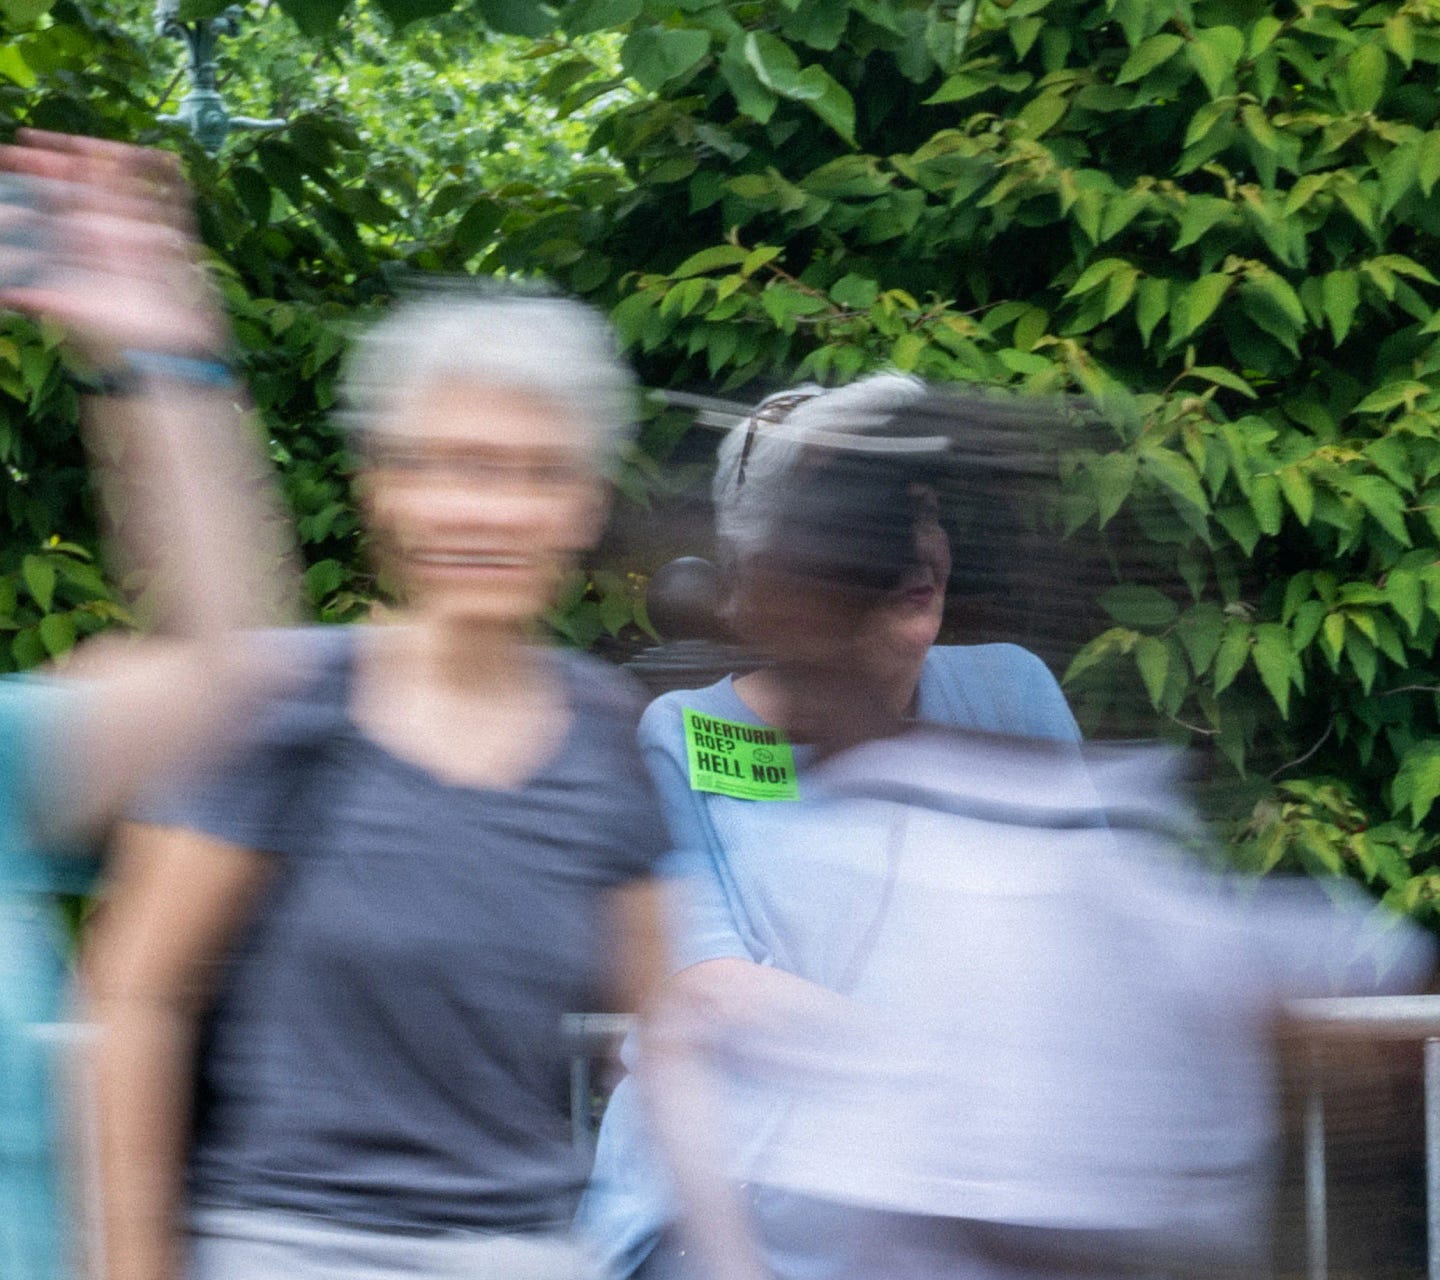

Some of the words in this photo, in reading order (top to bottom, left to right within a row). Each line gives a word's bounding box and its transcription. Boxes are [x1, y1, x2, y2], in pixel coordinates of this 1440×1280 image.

[691, 715, 777, 745] OVERTURN
[694, 732, 735, 755] ROE?
[697, 751, 745, 779] HELL
[751, 764, 788, 784] NO!
